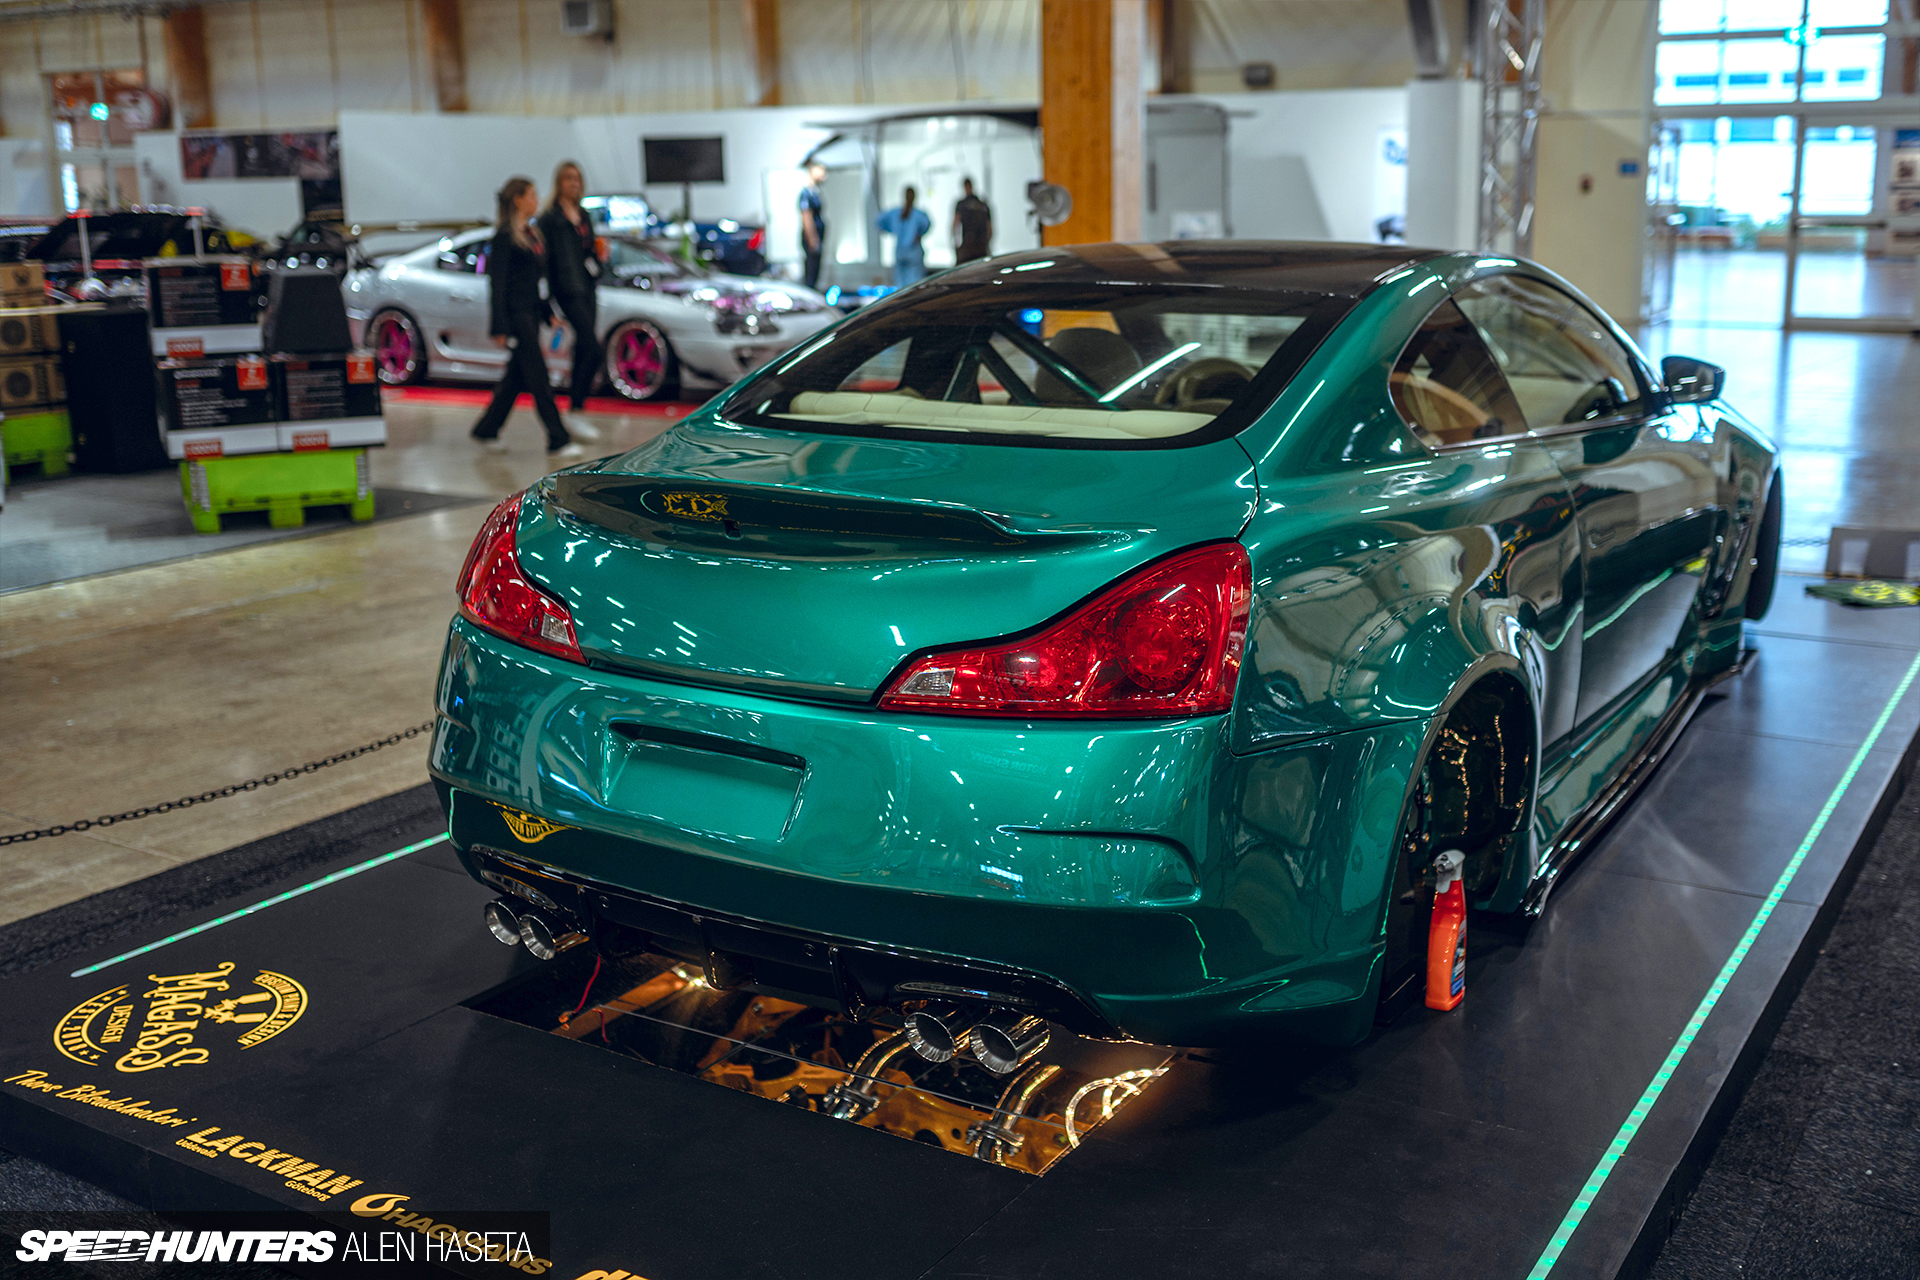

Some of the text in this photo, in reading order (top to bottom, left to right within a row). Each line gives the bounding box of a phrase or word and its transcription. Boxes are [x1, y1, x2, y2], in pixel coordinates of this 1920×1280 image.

[100, 1004, 134, 1044] DESIGN
[115, 961, 236, 1073] MAGASS
[175, 1138, 219, 1158] Uddevalla
[186, 1126, 365, 1196] LACKMAN
[284, 1180, 332, 1202] Göteborg
[381, 1206, 553, 1275] HAGMANS
